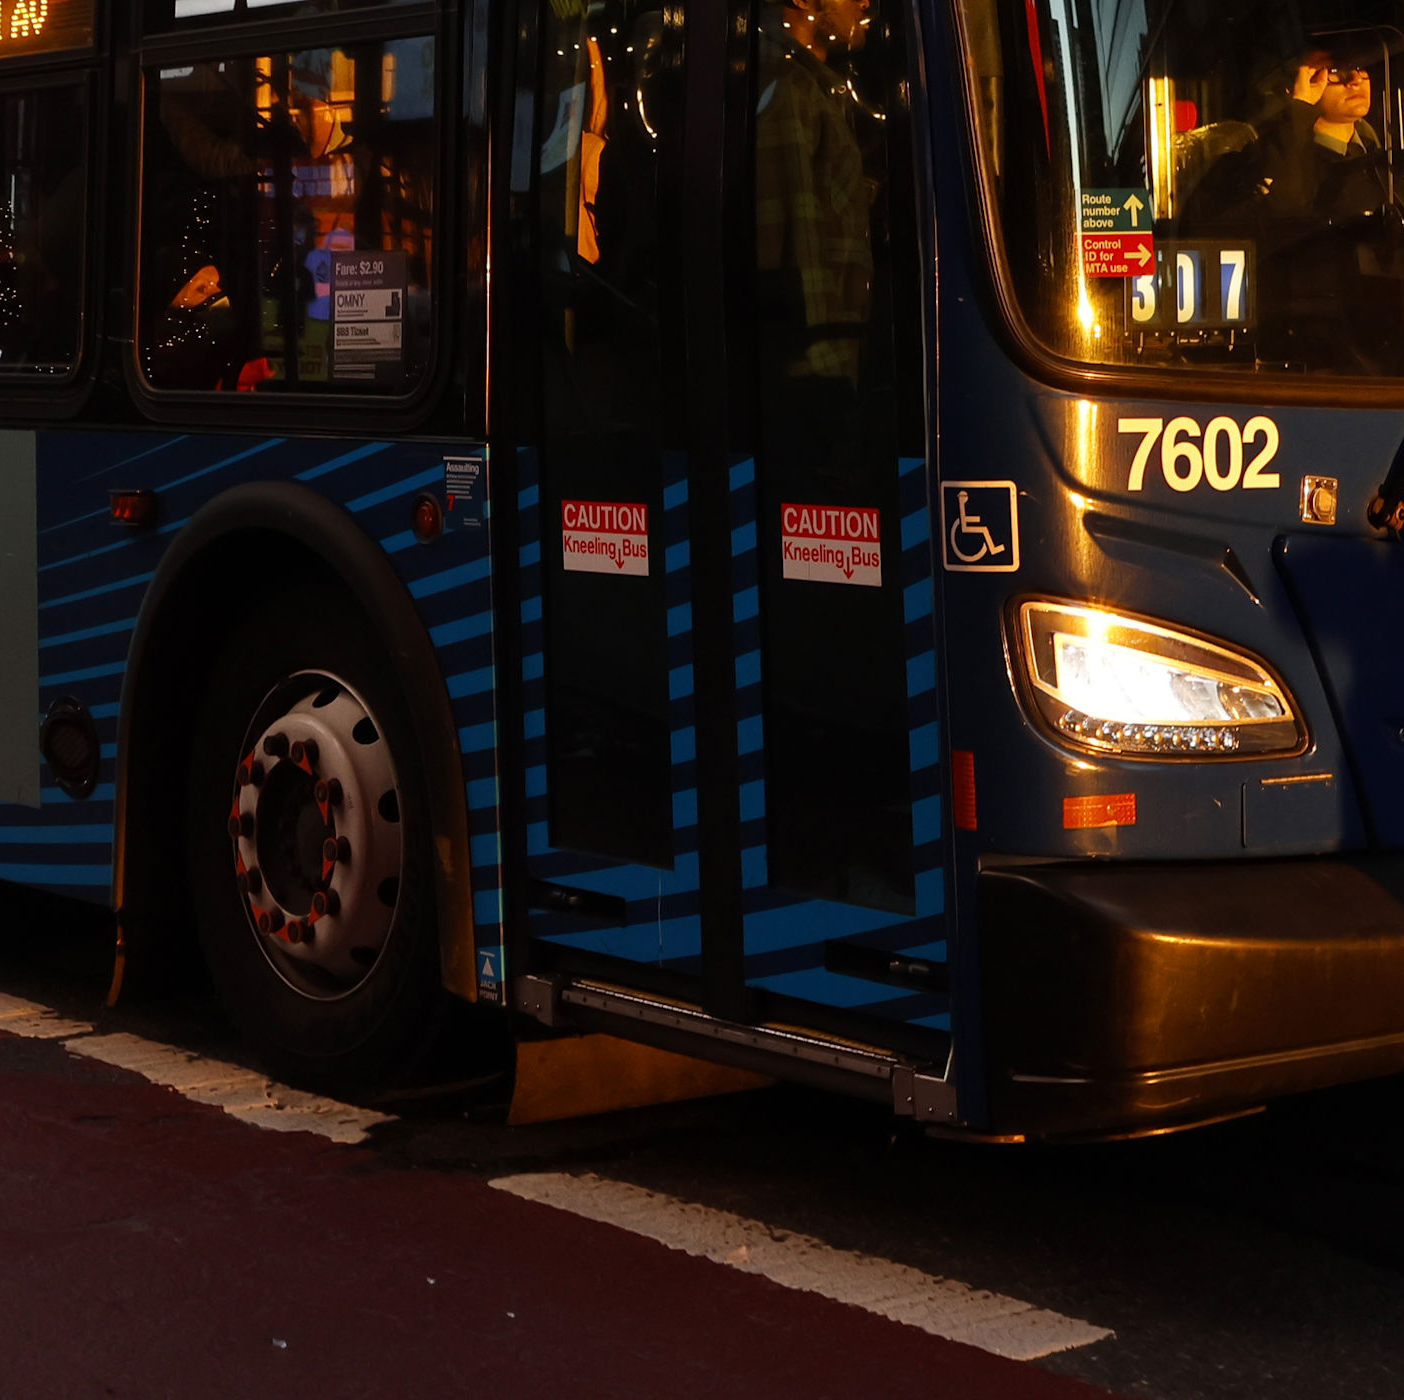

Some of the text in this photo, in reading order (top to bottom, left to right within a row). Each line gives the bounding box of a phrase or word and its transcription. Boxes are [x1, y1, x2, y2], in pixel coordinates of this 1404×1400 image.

[1082, 194, 1112, 205] Route
[1082, 206, 1121, 217] number
[1083, 218, 1115, 229] above
[1084, 239, 1122, 250] Control
[1085, 251, 1114, 262] ID for
[335, 260, 384, 275] Fare: $2.90
[1086, 263, 1129, 274] MTA use
[337, 294, 365, 307] OMNY
[1117, 415, 1281, 493] 7602
[446, 461, 480, 475] Assaulting
[563, 504, 646, 531] CAUTION
[783, 509, 878, 538] CAUTION
[563, 537, 647, 559] Kneeling Bus
[783, 541, 879, 569] Kneeling Bus
